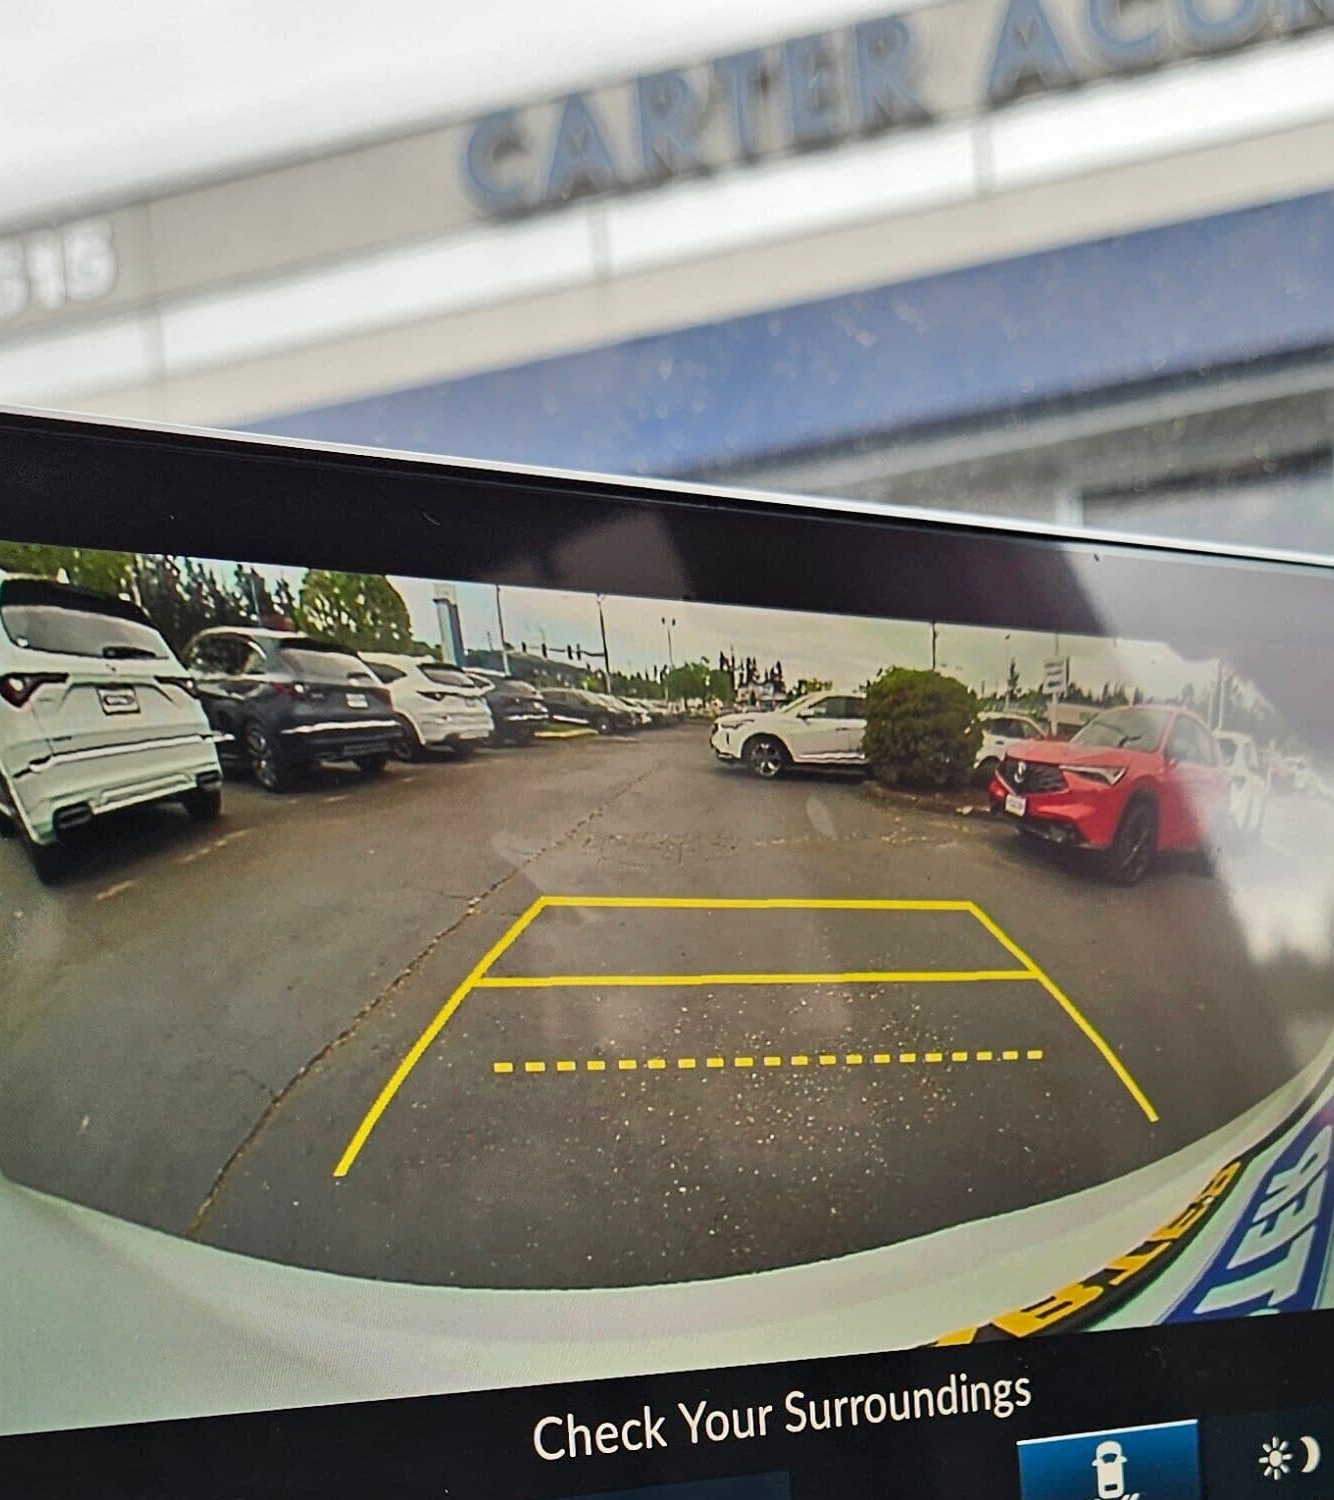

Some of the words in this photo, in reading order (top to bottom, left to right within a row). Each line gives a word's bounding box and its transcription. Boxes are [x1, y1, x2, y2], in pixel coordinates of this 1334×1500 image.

[463, 14, 931, 216] CARTER
[533, 1405, 667, 1461] Check
[678, 1400, 773, 1445] Your
[785, 1373, 1032, 1433] Surroundings
